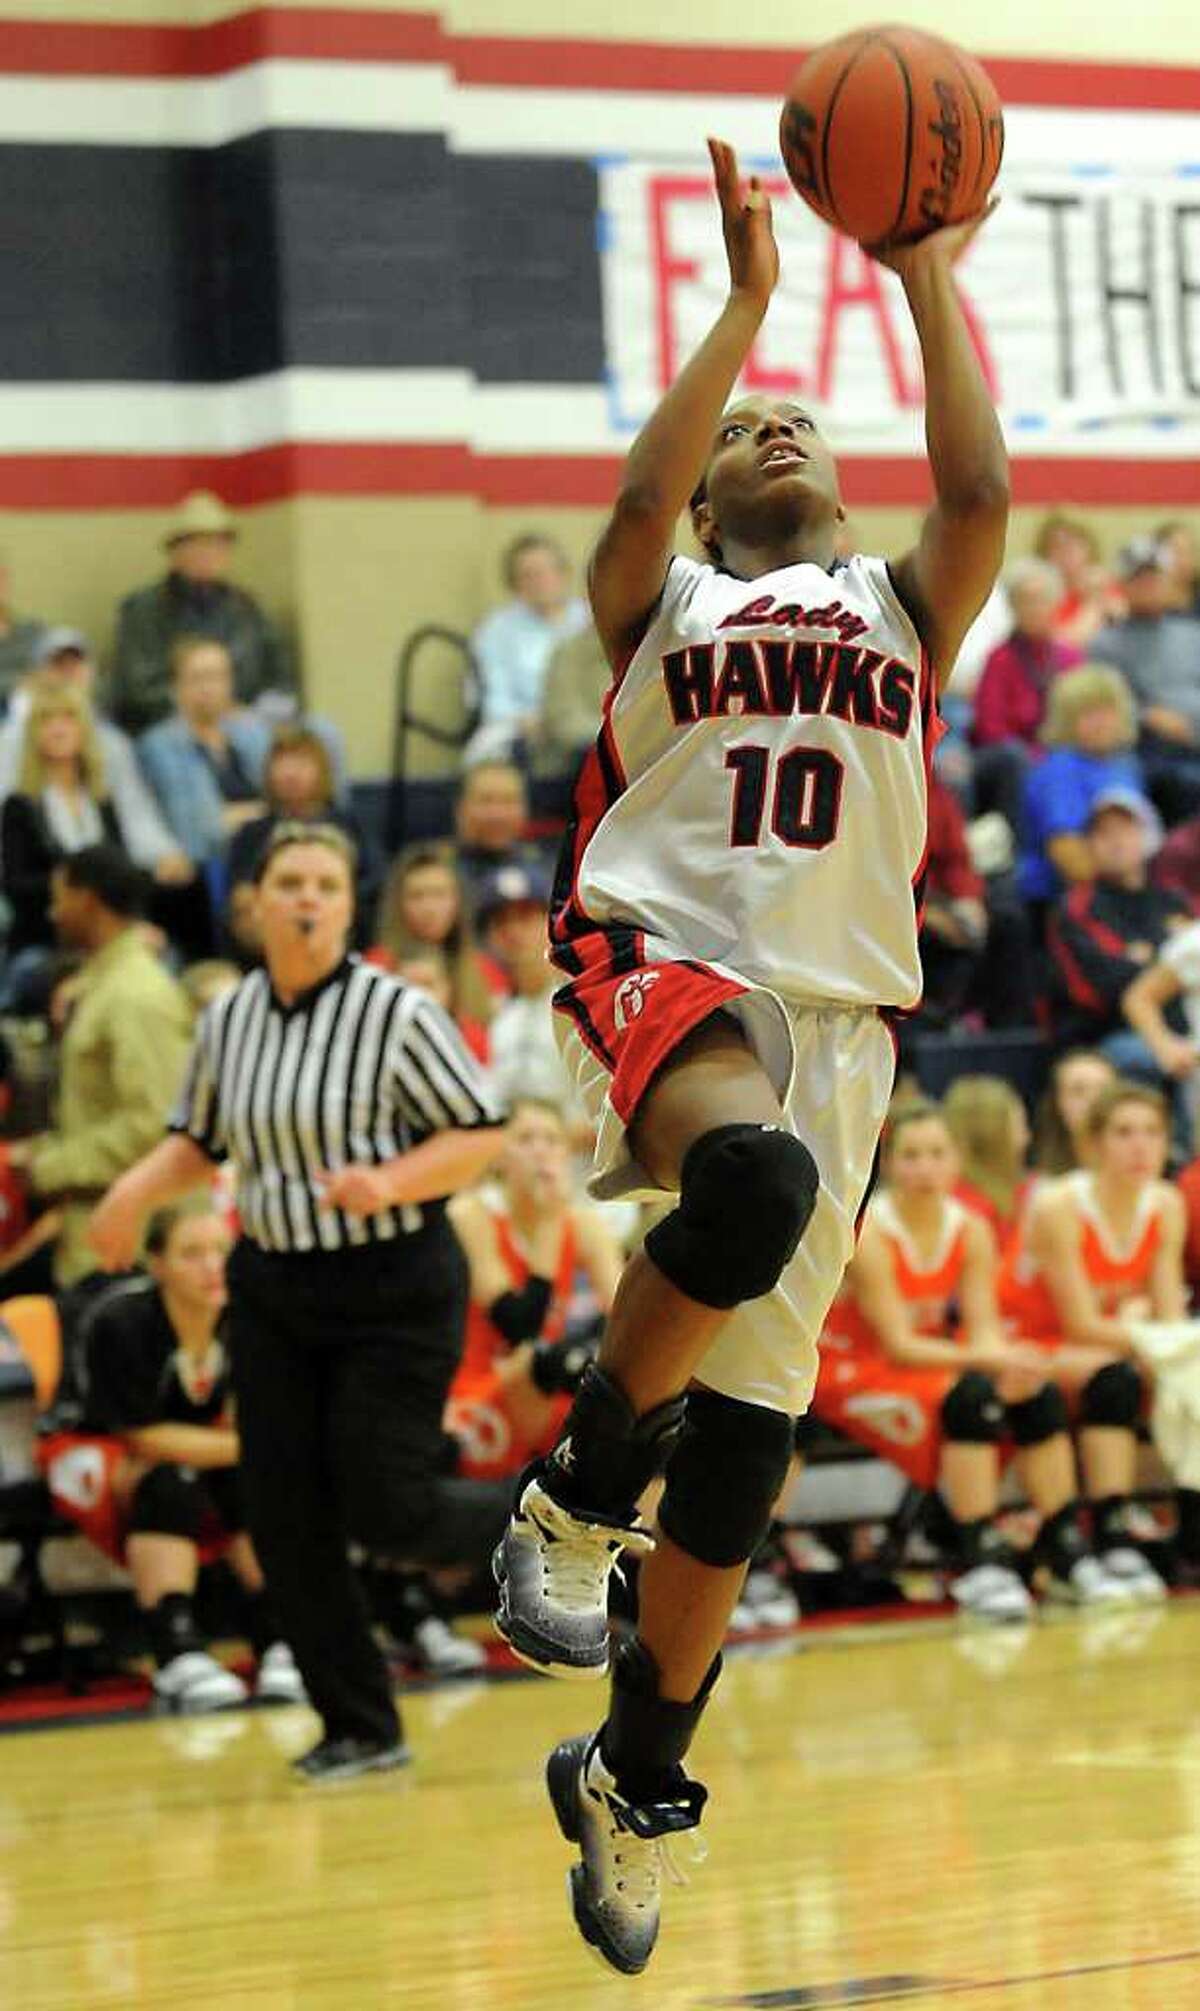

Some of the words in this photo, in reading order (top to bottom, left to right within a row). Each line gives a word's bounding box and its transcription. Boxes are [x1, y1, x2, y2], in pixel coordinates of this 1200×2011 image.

[1019, 191, 1200, 400] THE
[715, 594, 870, 643] Lady
[661, 638, 916, 741] HAWKS
[723, 745, 846, 851] 10
